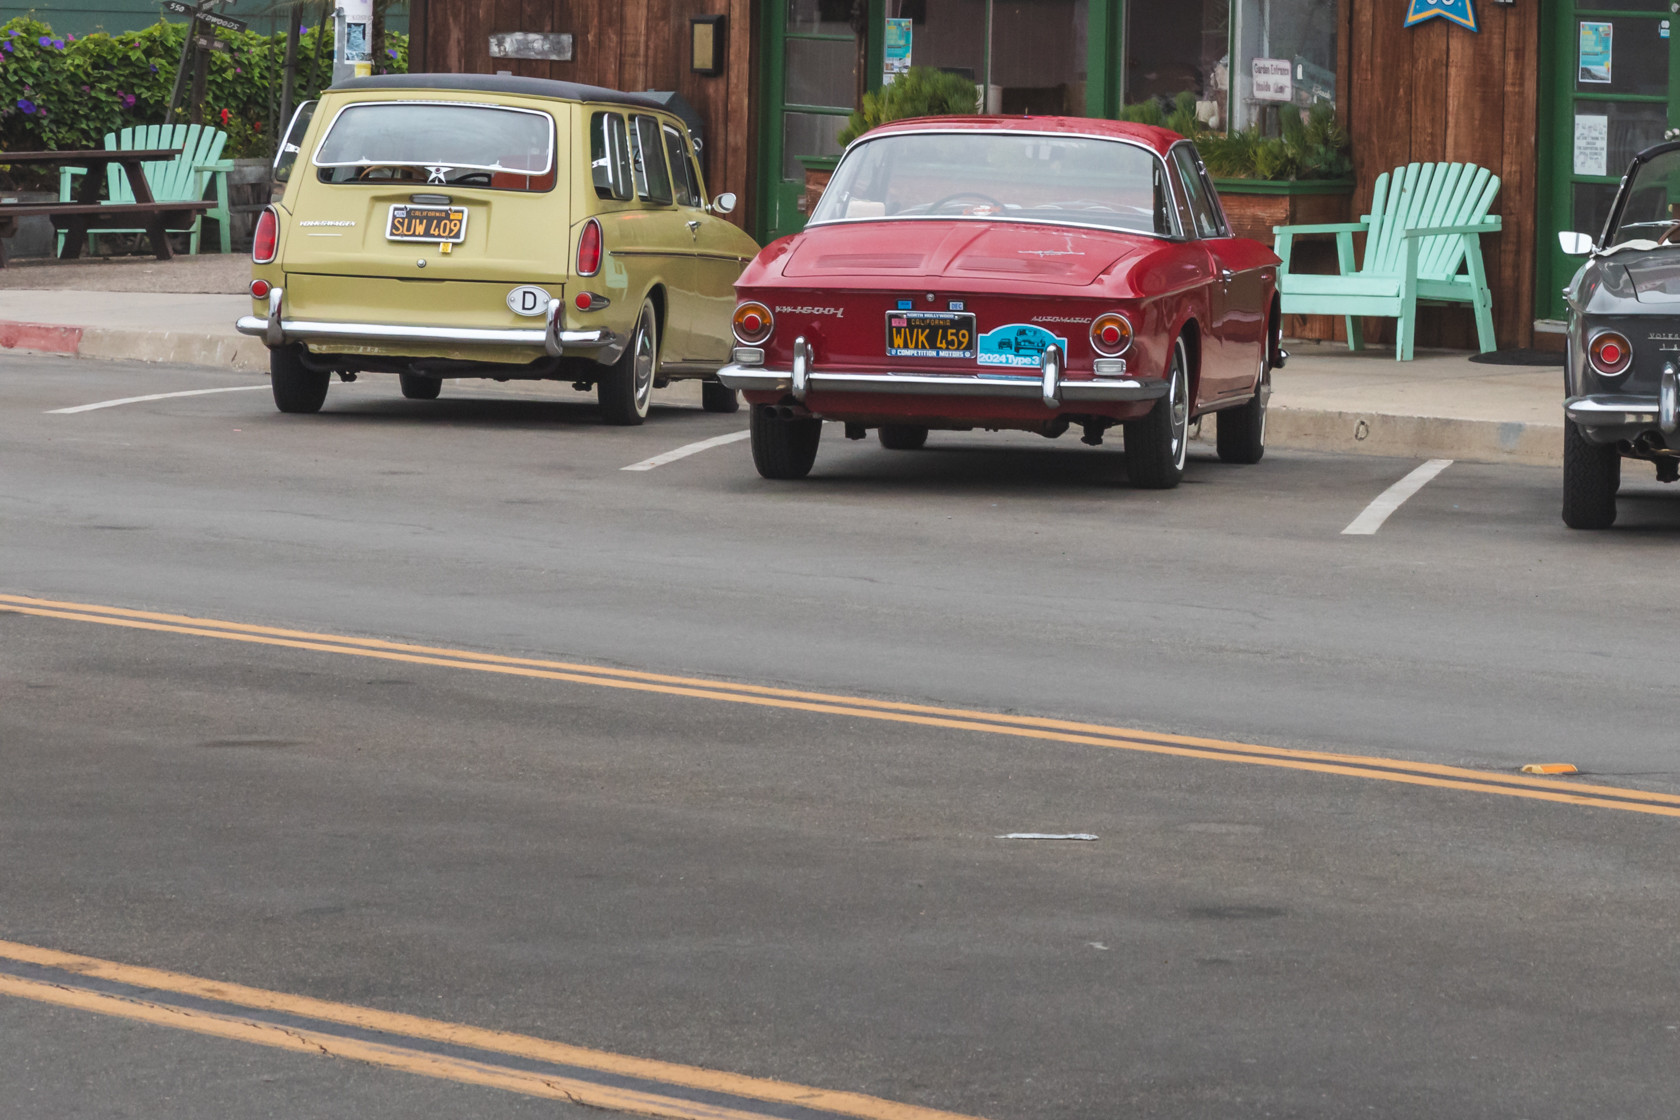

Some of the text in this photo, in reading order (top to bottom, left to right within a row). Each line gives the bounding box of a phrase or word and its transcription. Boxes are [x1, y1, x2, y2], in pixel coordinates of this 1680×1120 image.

[169, 2, 186, 13] 550
[392, 218, 461, 237] SUW 409
[522, 291, 537, 311] D
[1031, 316, 1092, 324] AUTOMATIC
[892, 327, 969, 350] WVK 459
[979, 353, 1040, 366] 2024 Type 3
